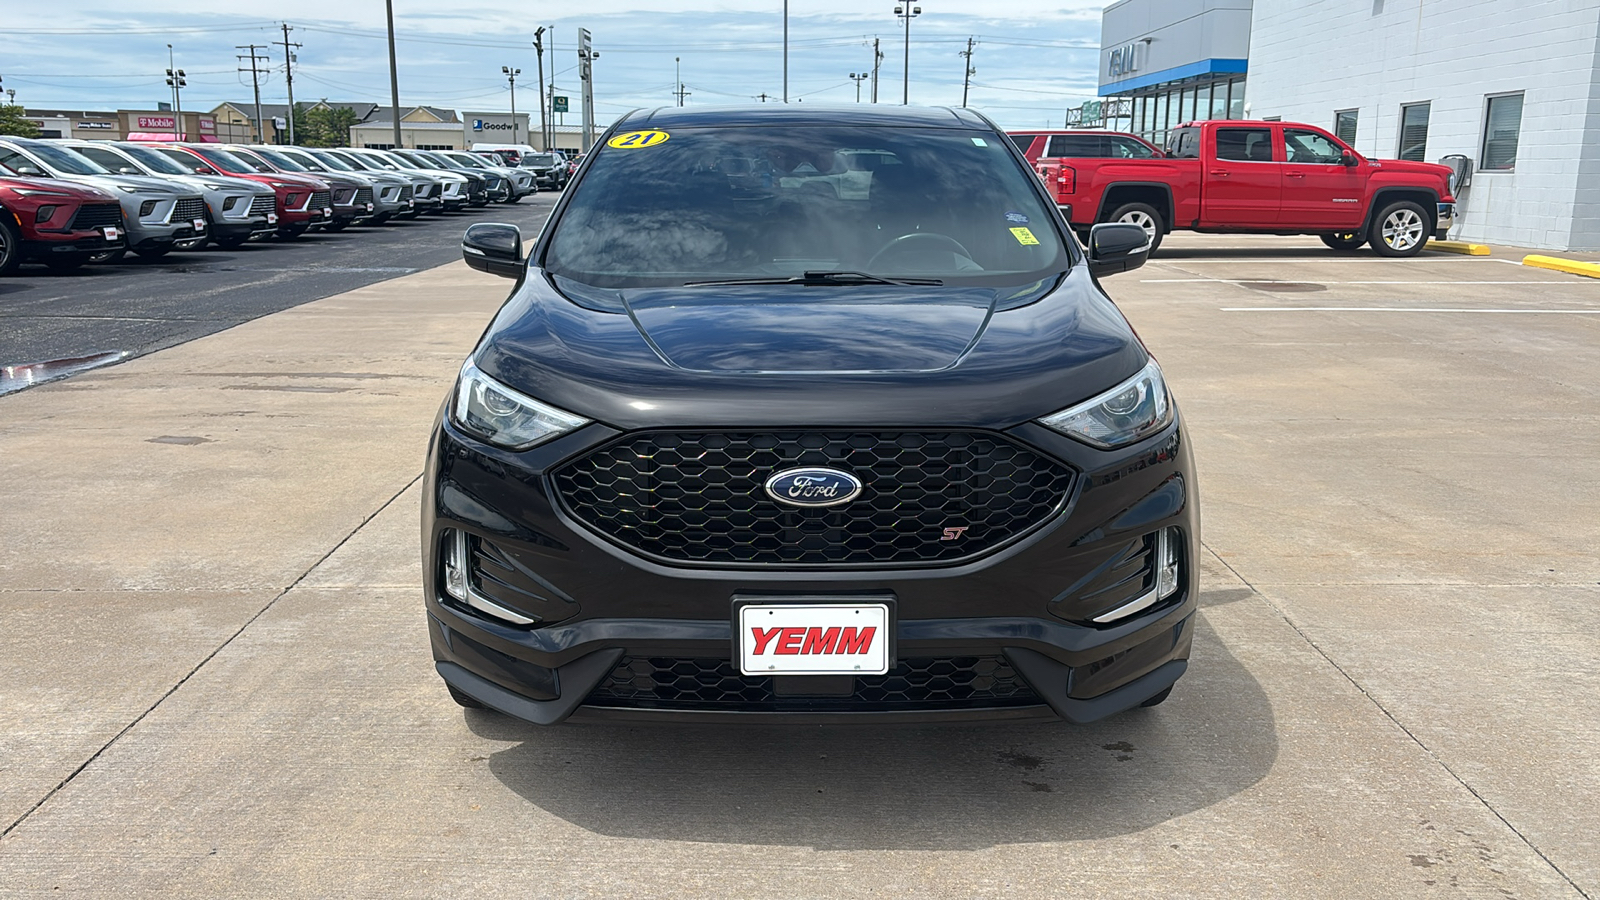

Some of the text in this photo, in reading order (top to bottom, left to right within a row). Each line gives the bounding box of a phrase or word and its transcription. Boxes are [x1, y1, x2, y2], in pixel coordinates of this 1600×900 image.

[147, 118, 173, 127] Mobile
[619, 133, 657, 146] 21
[788, 475, 839, 497] Ford
[940, 526, 968, 540] ST
[751, 626, 877, 655] YEMM
